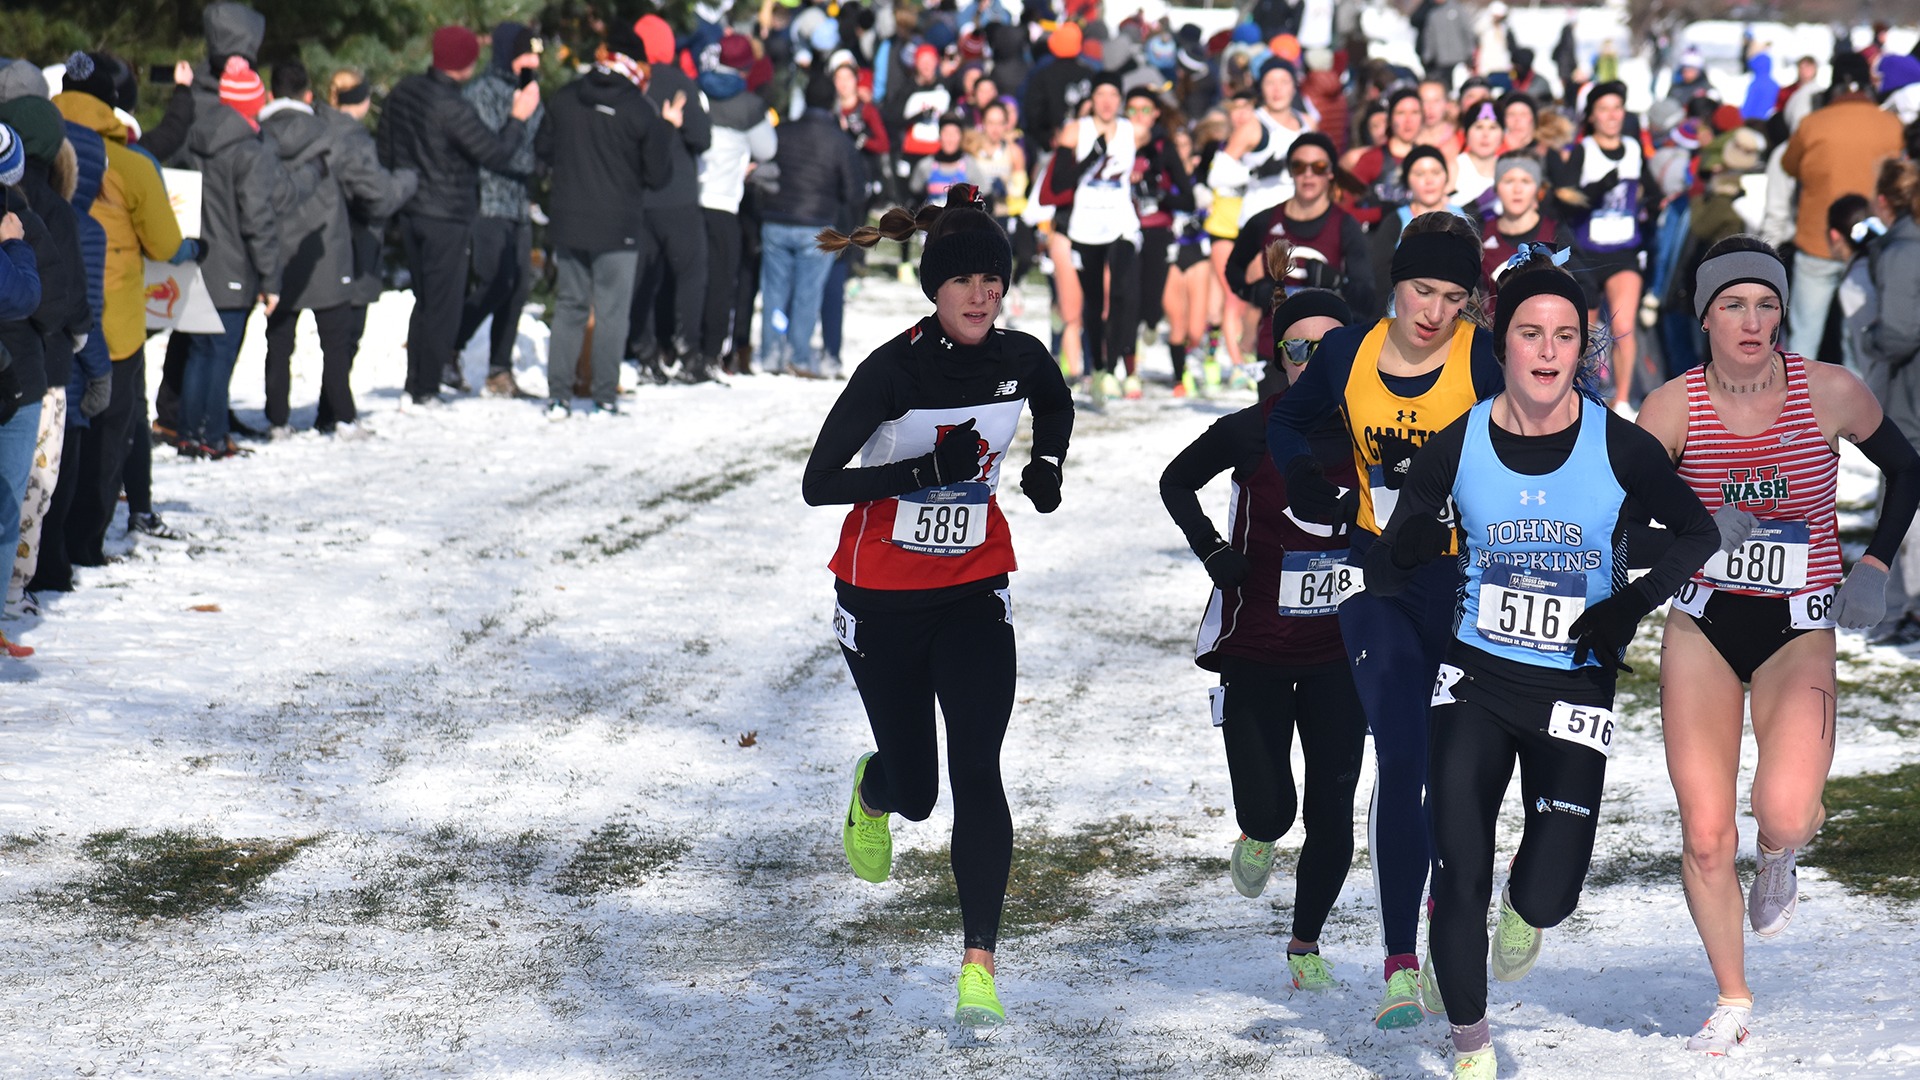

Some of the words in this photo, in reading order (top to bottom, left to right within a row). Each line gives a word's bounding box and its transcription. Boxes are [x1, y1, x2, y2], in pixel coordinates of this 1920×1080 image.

[1721, 478, 1789, 504] WASH
[914, 506, 970, 544] 589
[1487, 519, 1582, 547] JOHNS
[1475, 547, 1602, 572] HOPKINS
[1726, 542, 1786, 585] 680
[1300, 572, 1334, 606] 64
[1499, 590, 1561, 639] 516
[1807, 593, 1833, 621] 68
[1567, 708, 1614, 746] 516
[1552, 800, 1590, 815] HOPKINS
